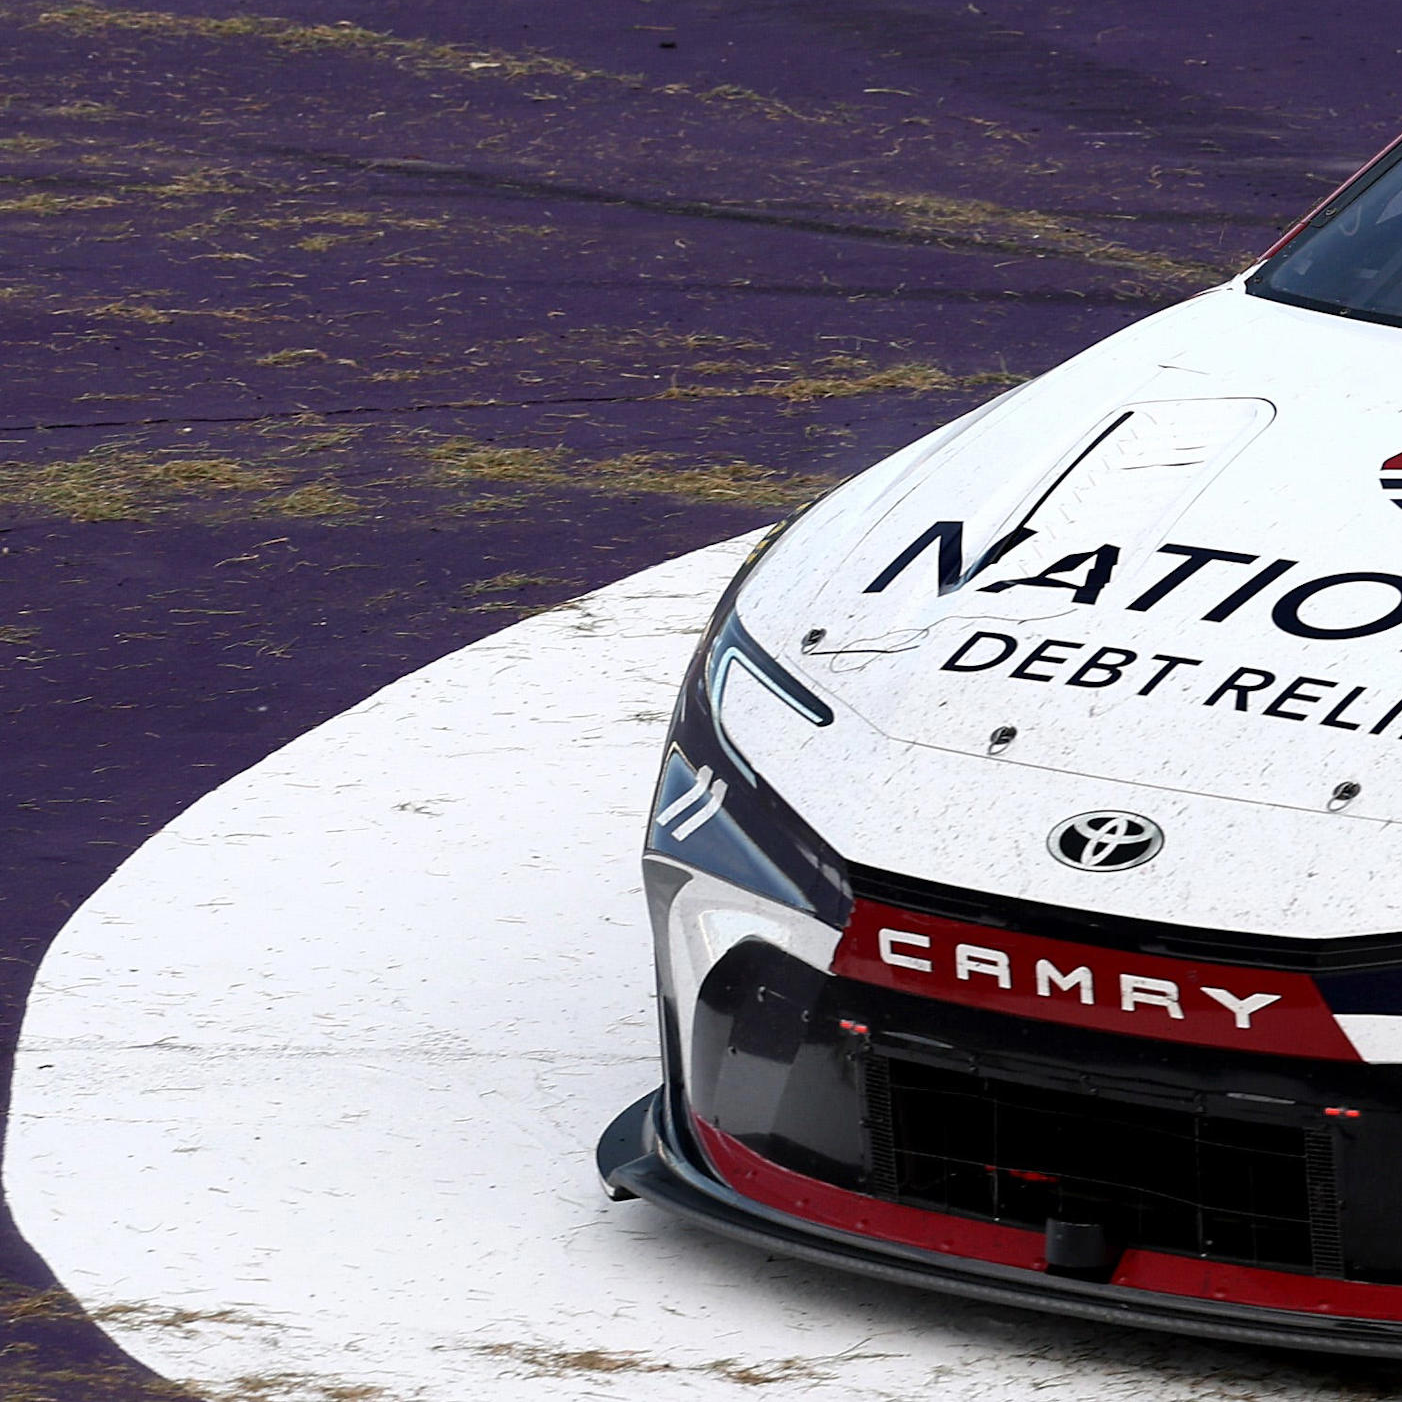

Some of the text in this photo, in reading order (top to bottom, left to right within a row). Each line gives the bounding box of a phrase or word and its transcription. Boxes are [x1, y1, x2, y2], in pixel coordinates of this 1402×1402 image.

[940, 629, 1204, 697] DEBT
[655, 764, 728, 841] 11
[878, 927, 1282, 1030] CAMRY
